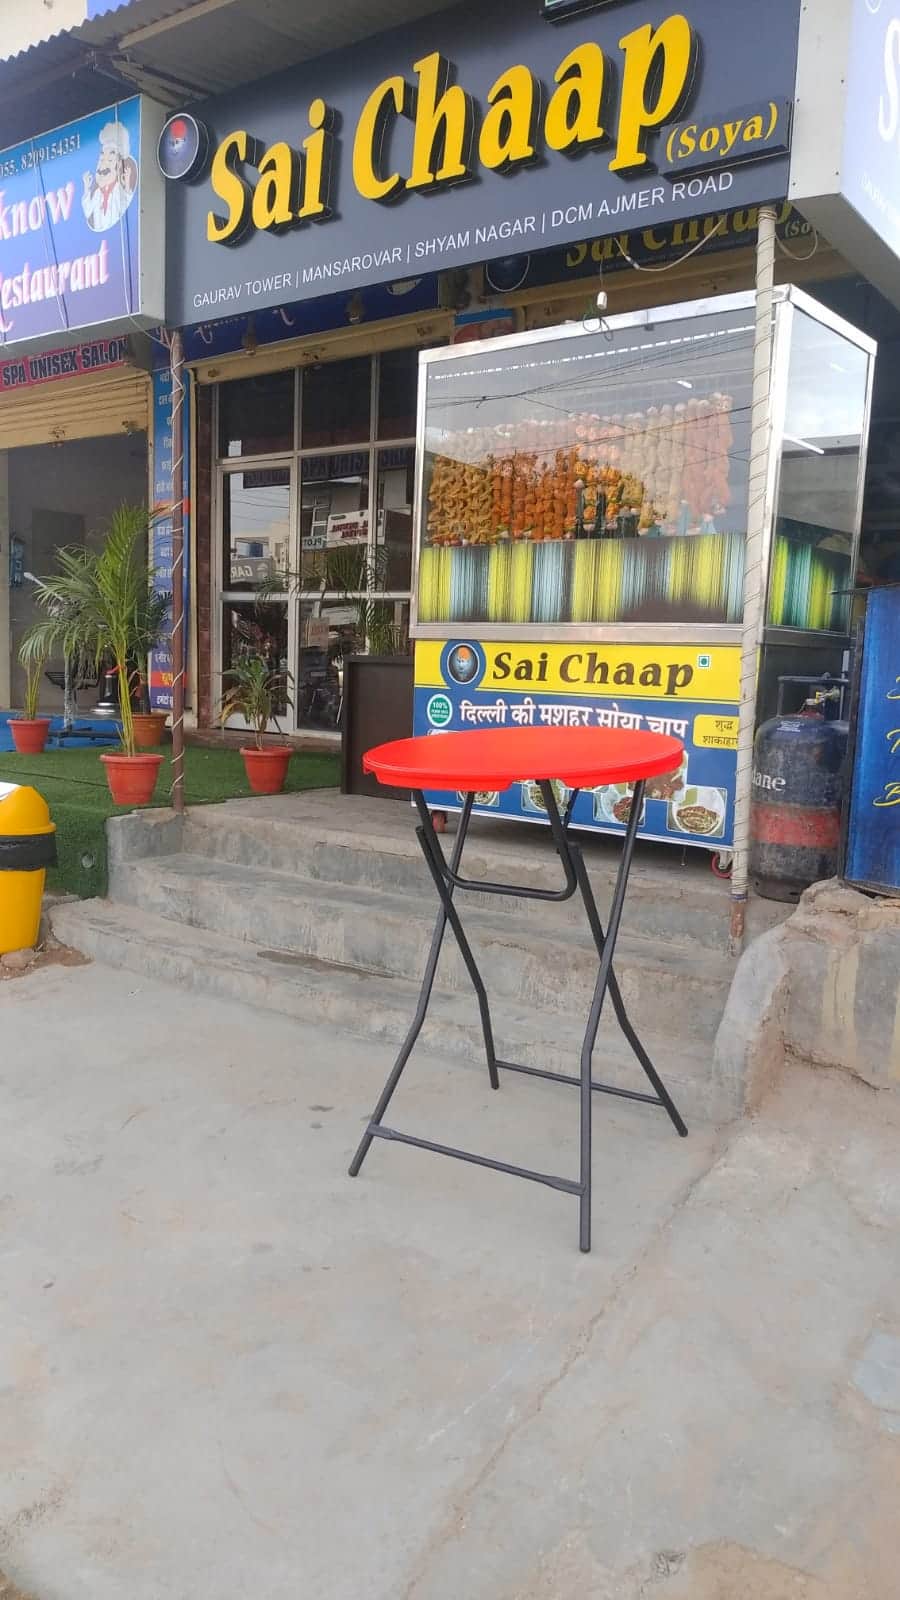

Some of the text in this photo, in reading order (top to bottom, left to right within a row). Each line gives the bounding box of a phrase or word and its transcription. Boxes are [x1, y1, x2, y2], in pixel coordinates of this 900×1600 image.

[207, 14, 693, 242] Sai Chaap
[665, 102, 778, 163] (Soya)
[193, 284, 242, 308] GAURAV
[245, 272, 291, 296] TOWER
[302, 247, 402, 284] MANSAROVAR
[415, 231, 470, 258] SHYAM
[475, 215, 536, 245] NAGAR
[552, 203, 593, 227] DCM
[598, 187, 665, 217] AJMER
[672, 172, 733, 202] ROAD
[0, 240, 109, 310] estaurant
[3, 364, 26, 386] SPA
[29, 349, 78, 380] UNISEX
[493, 652, 694, 695] Sai Chaap
[459, 700, 508, 725] दिल्ली
[510, 697, 536, 724] की
[596, 702, 644, 730] सोया
[645, 716, 688, 738] चाप
